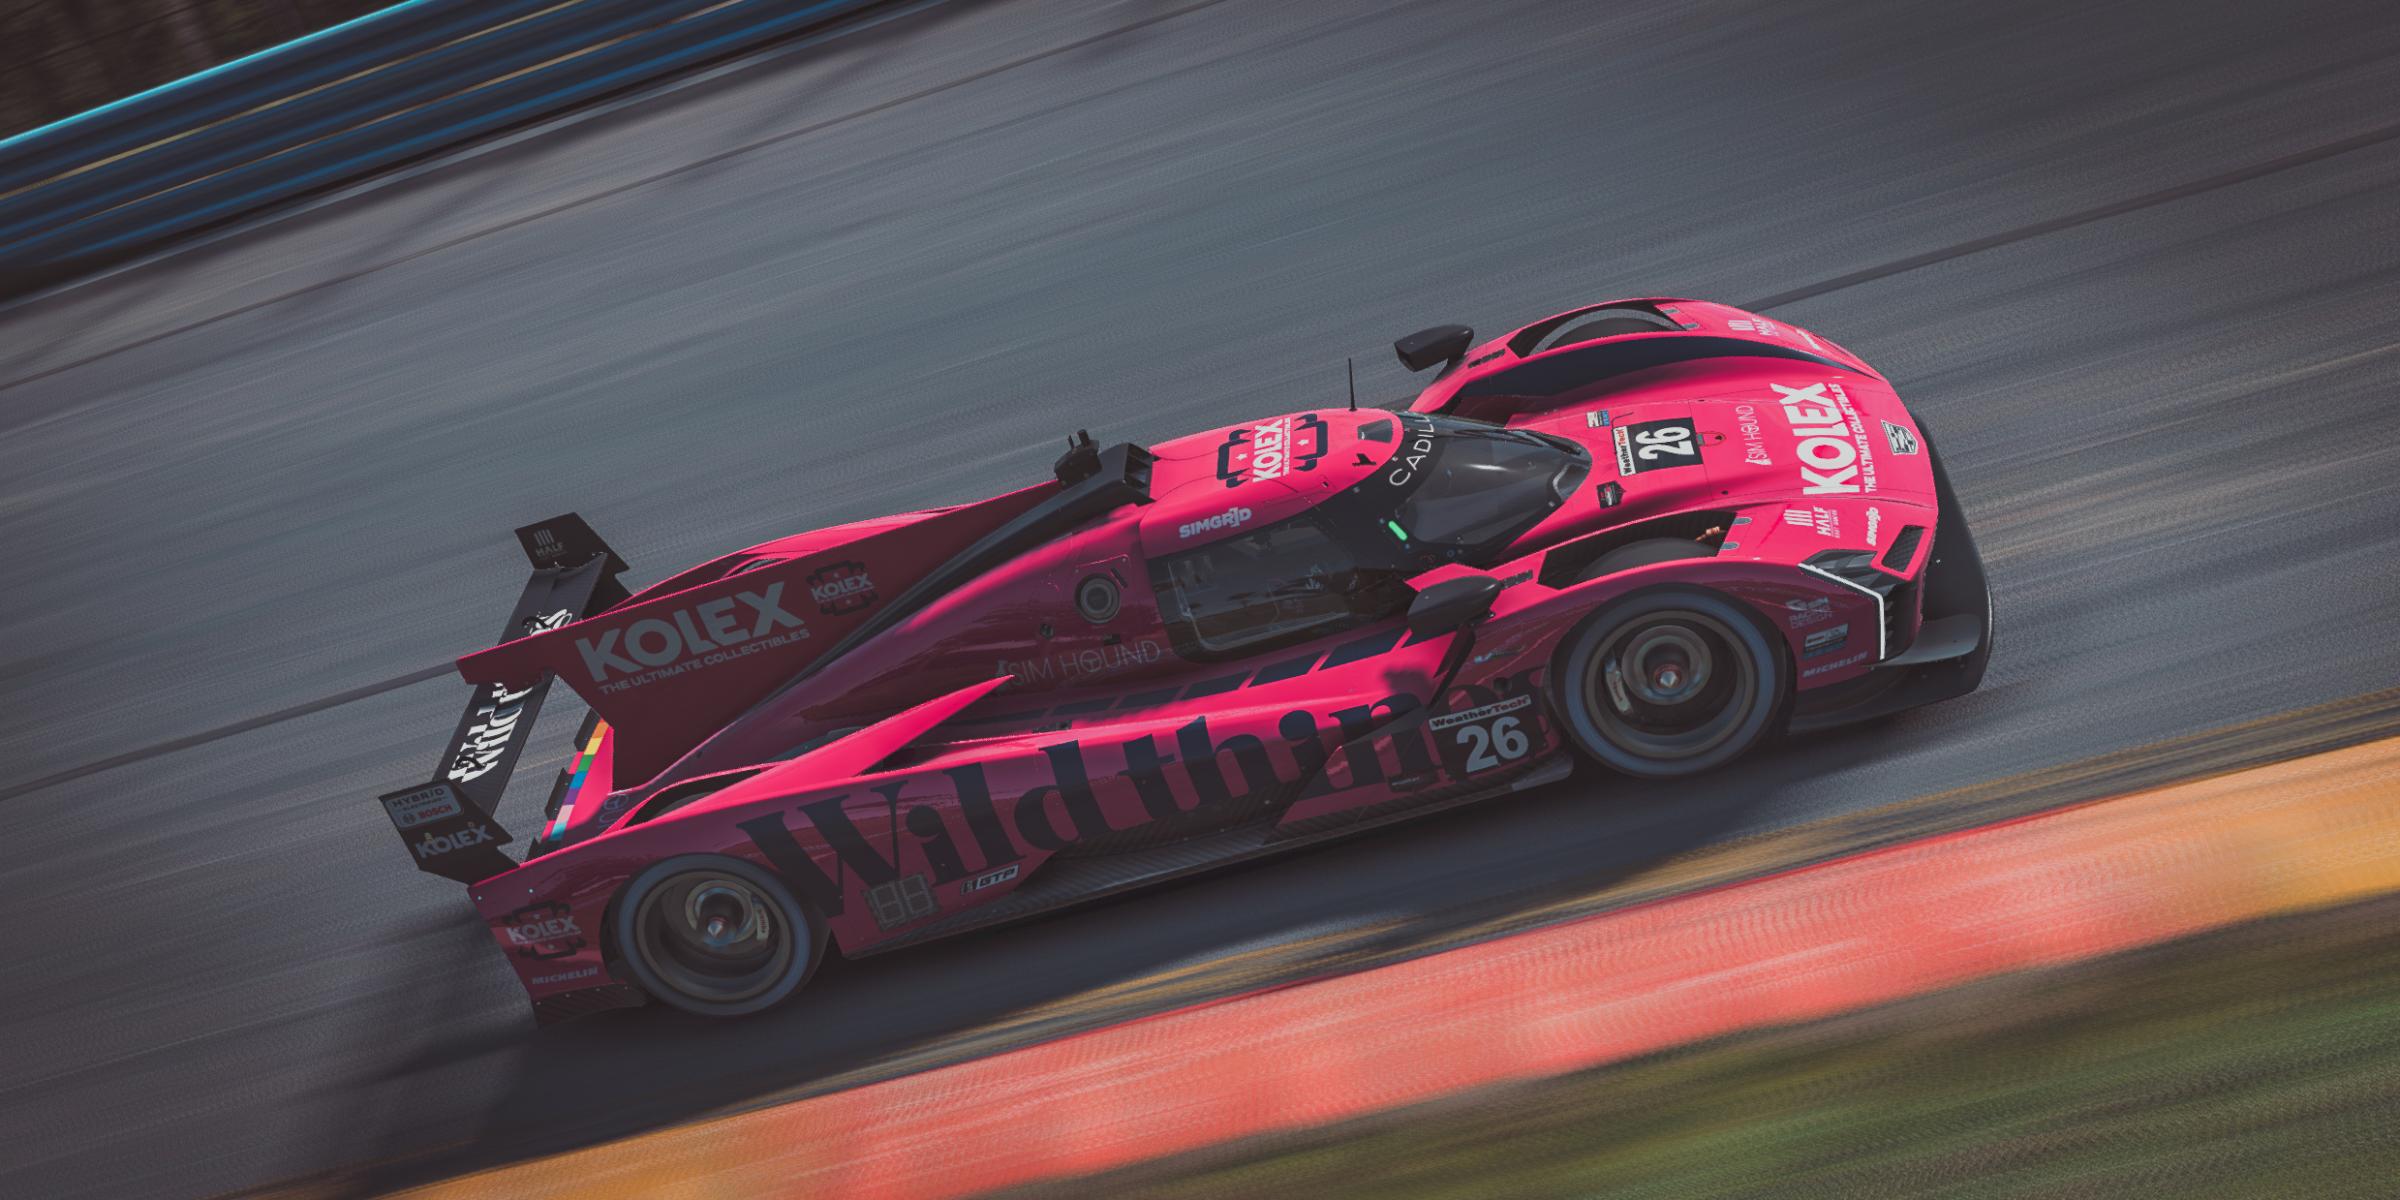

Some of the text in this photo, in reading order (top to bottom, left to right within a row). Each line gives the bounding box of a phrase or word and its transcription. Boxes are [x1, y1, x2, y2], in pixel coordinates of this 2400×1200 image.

[1827, 383, 1865, 433] COLLECTIBLES
[1253, 418, 1284, 483] KOLEX
[1615, 429, 1633, 475] WeatherTech
[1636, 426, 1694, 460] 26
[1770, 382, 1860, 495] KOLEX
[1855, 434, 1875, 476] ULTIMATE
[1813, 506, 1832, 536] HALF
[811, 573, 872, 600] KOLEX
[576, 581, 804, 682] KOLEX
[600, 629, 810, 695] THE ULTIMATE COLLECTIBLES
[1008, 656, 1054, 686] SIM
[1803, 652, 1868, 677] MICHELIN
[1432, 698, 1528, 728] WeatherTech
[1456, 716, 1529, 773] 26
[415, 825, 494, 858] KOLEX
[736, 742, 1106, 918] Wild
[978, 867, 1016, 887] GTP
[506, 916, 581, 942] KOLEX
[532, 966, 598, 984] MICHELIN
